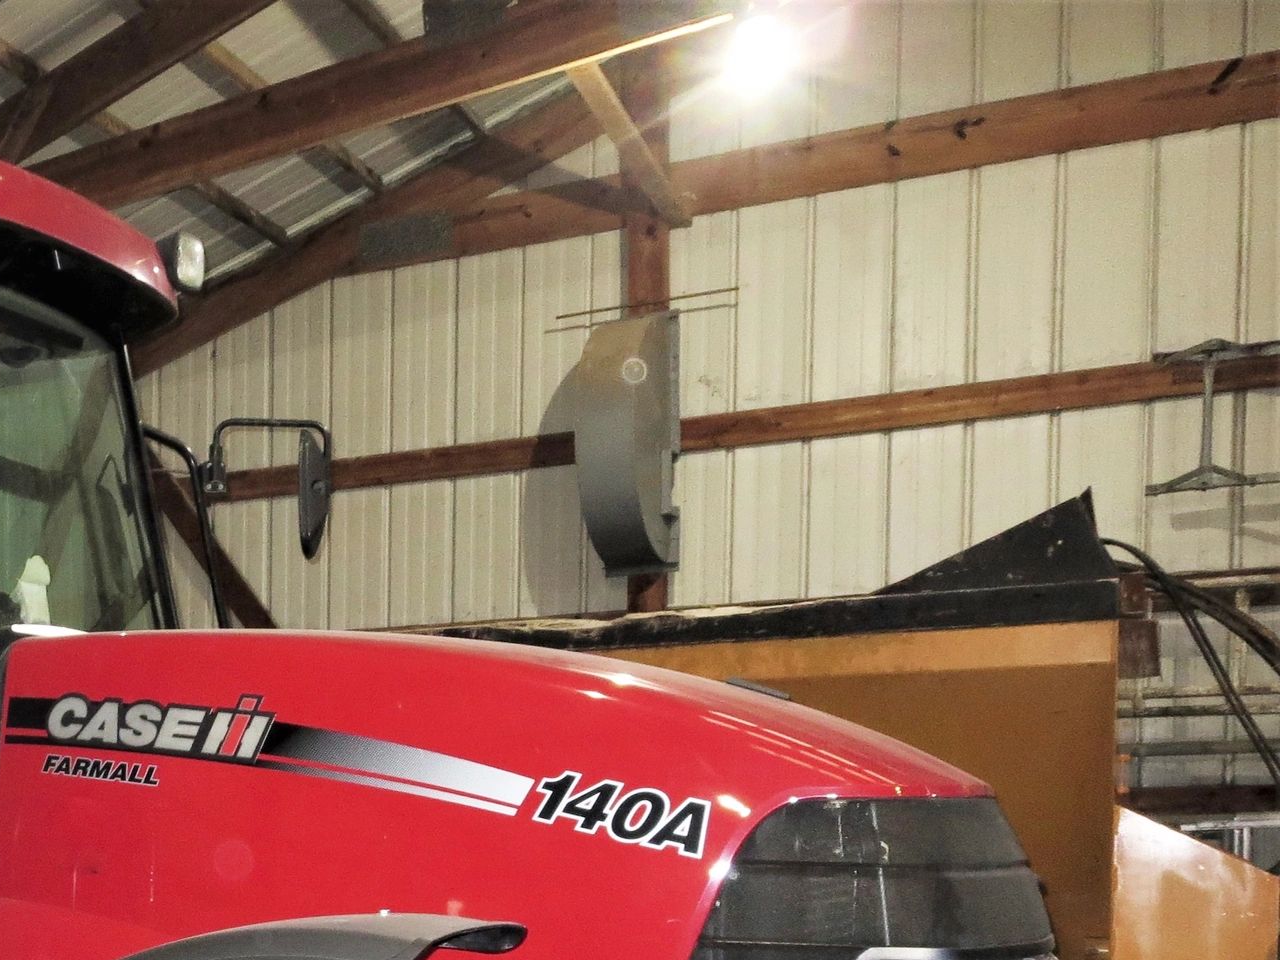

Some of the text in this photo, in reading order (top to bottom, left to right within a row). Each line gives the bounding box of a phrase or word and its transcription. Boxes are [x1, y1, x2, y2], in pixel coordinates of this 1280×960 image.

[47, 696, 207, 752] CASE
[41, 754, 160, 787] FARMALL
[532, 770, 712, 860] 140A
